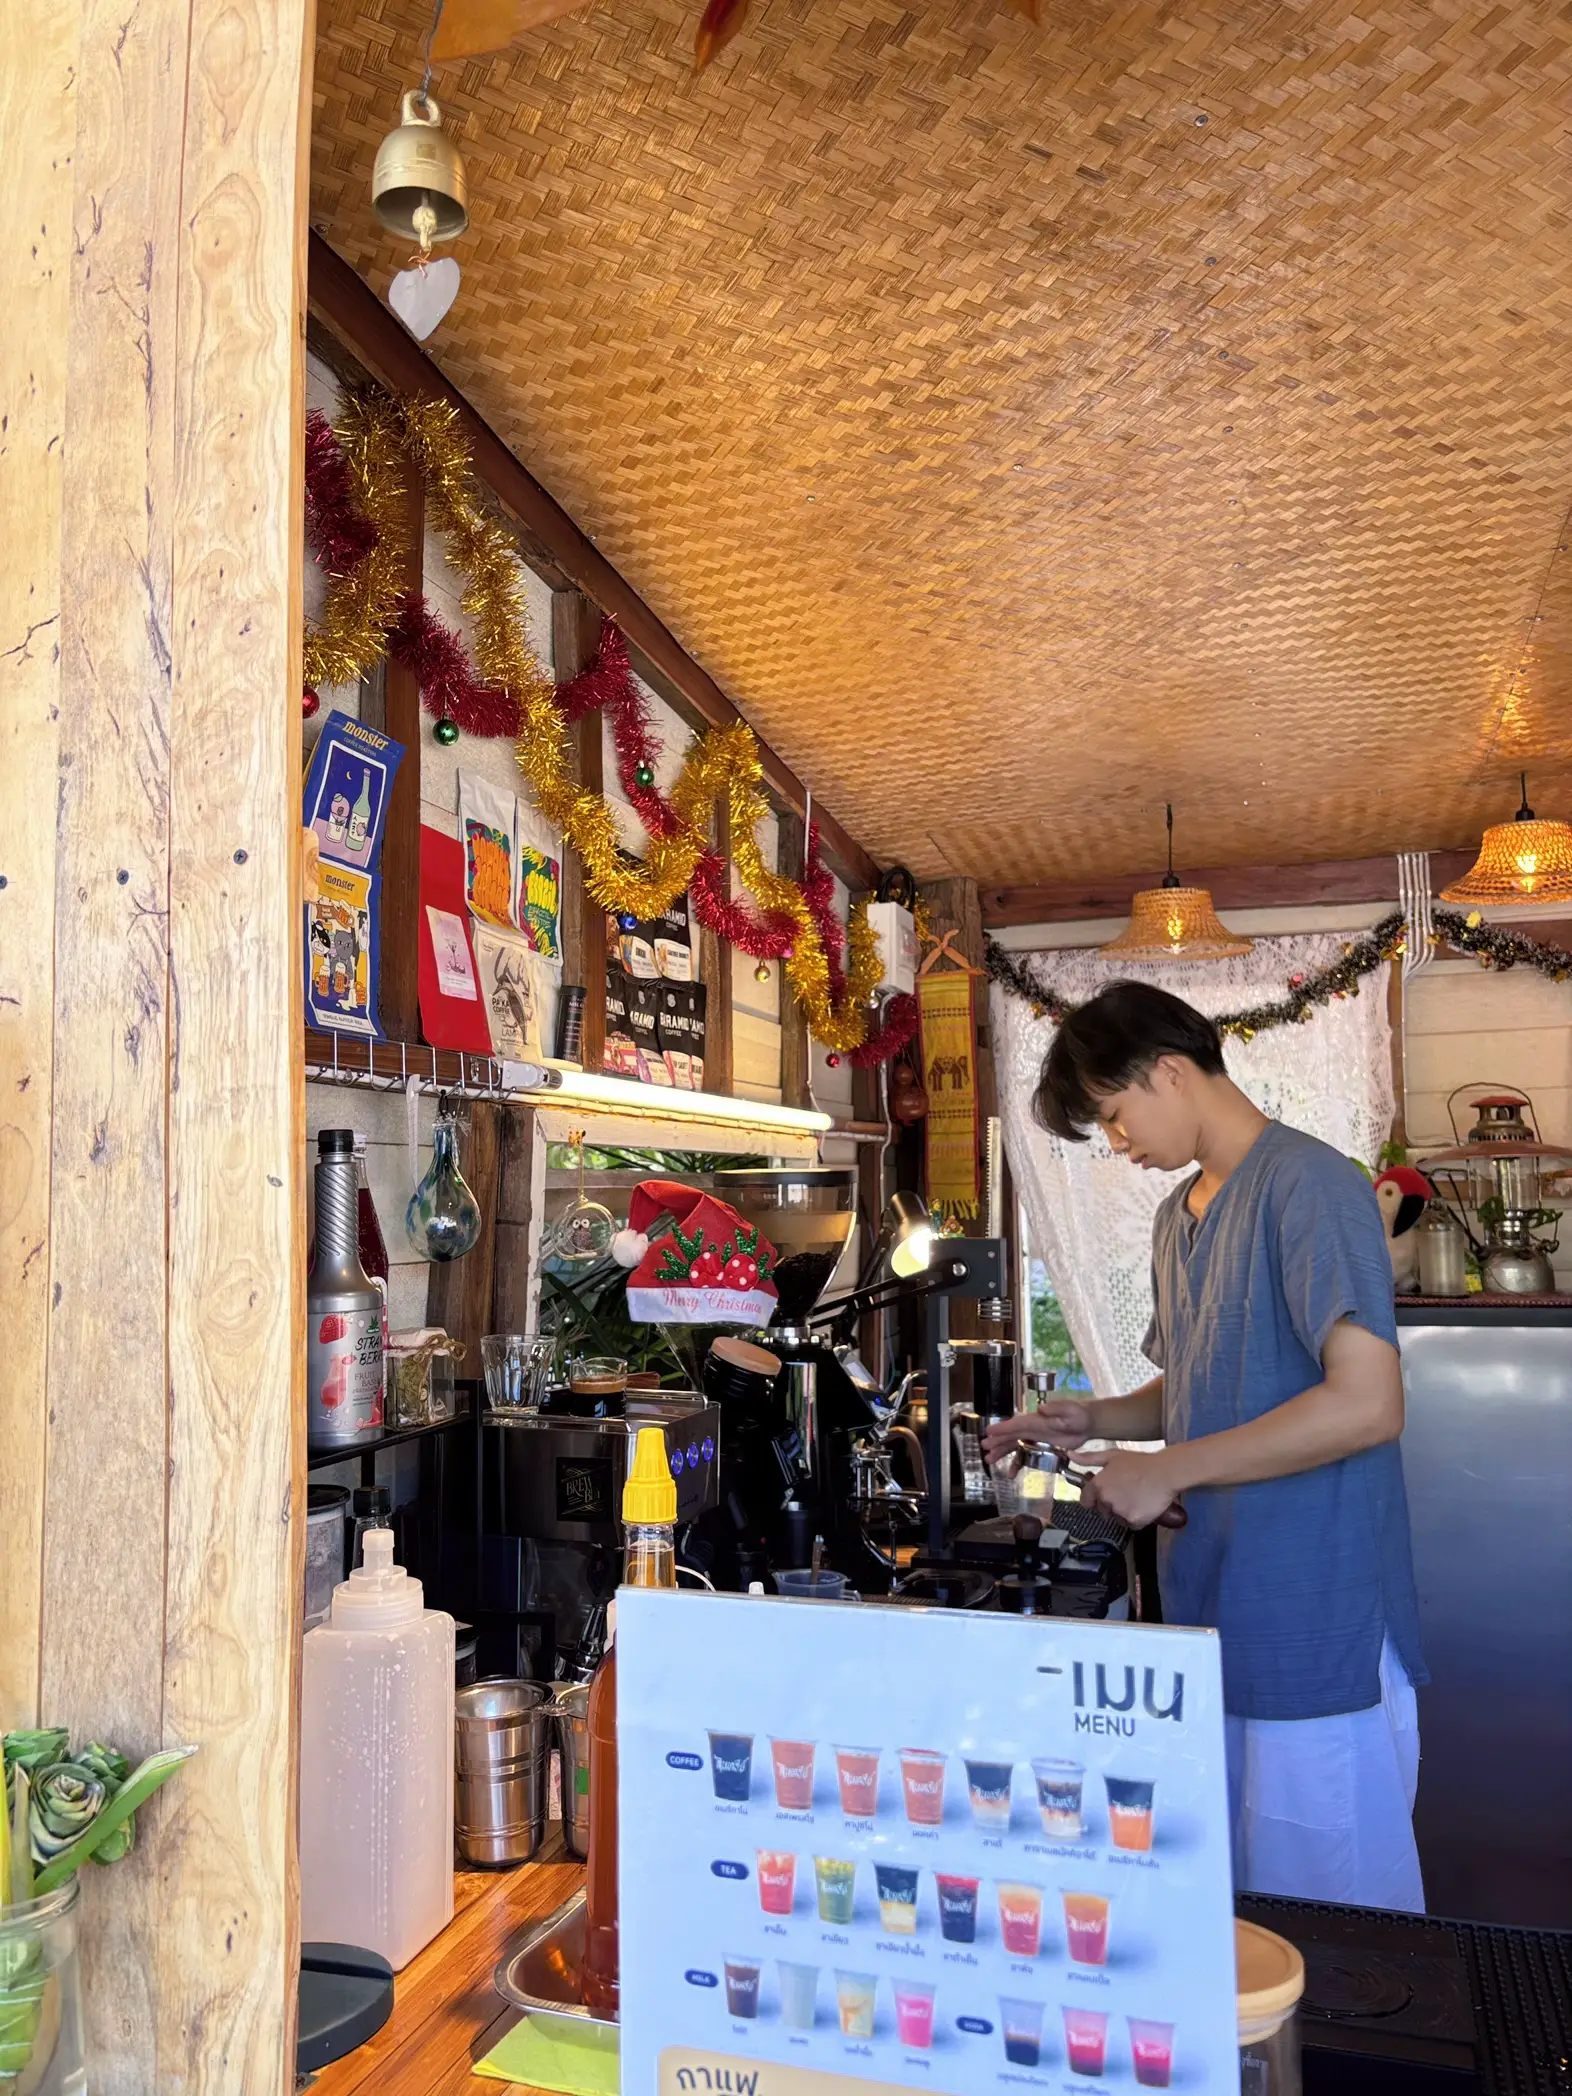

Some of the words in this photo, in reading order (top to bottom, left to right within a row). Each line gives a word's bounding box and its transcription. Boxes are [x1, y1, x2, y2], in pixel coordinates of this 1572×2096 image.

[342, 721, 388, 750] monster
[325, 874, 355, 891] monster
[665, 1028, 682, 1037] COFFEE
[354, 1371, 376, 1381] FRUIT
[1074, 1712, 1136, 1737] MENU
[669, 1755, 700, 1768] COFFEE
[720, 1864, 737, 1877] TEA
[676, 2066, 759, 2096] กาแฟ
